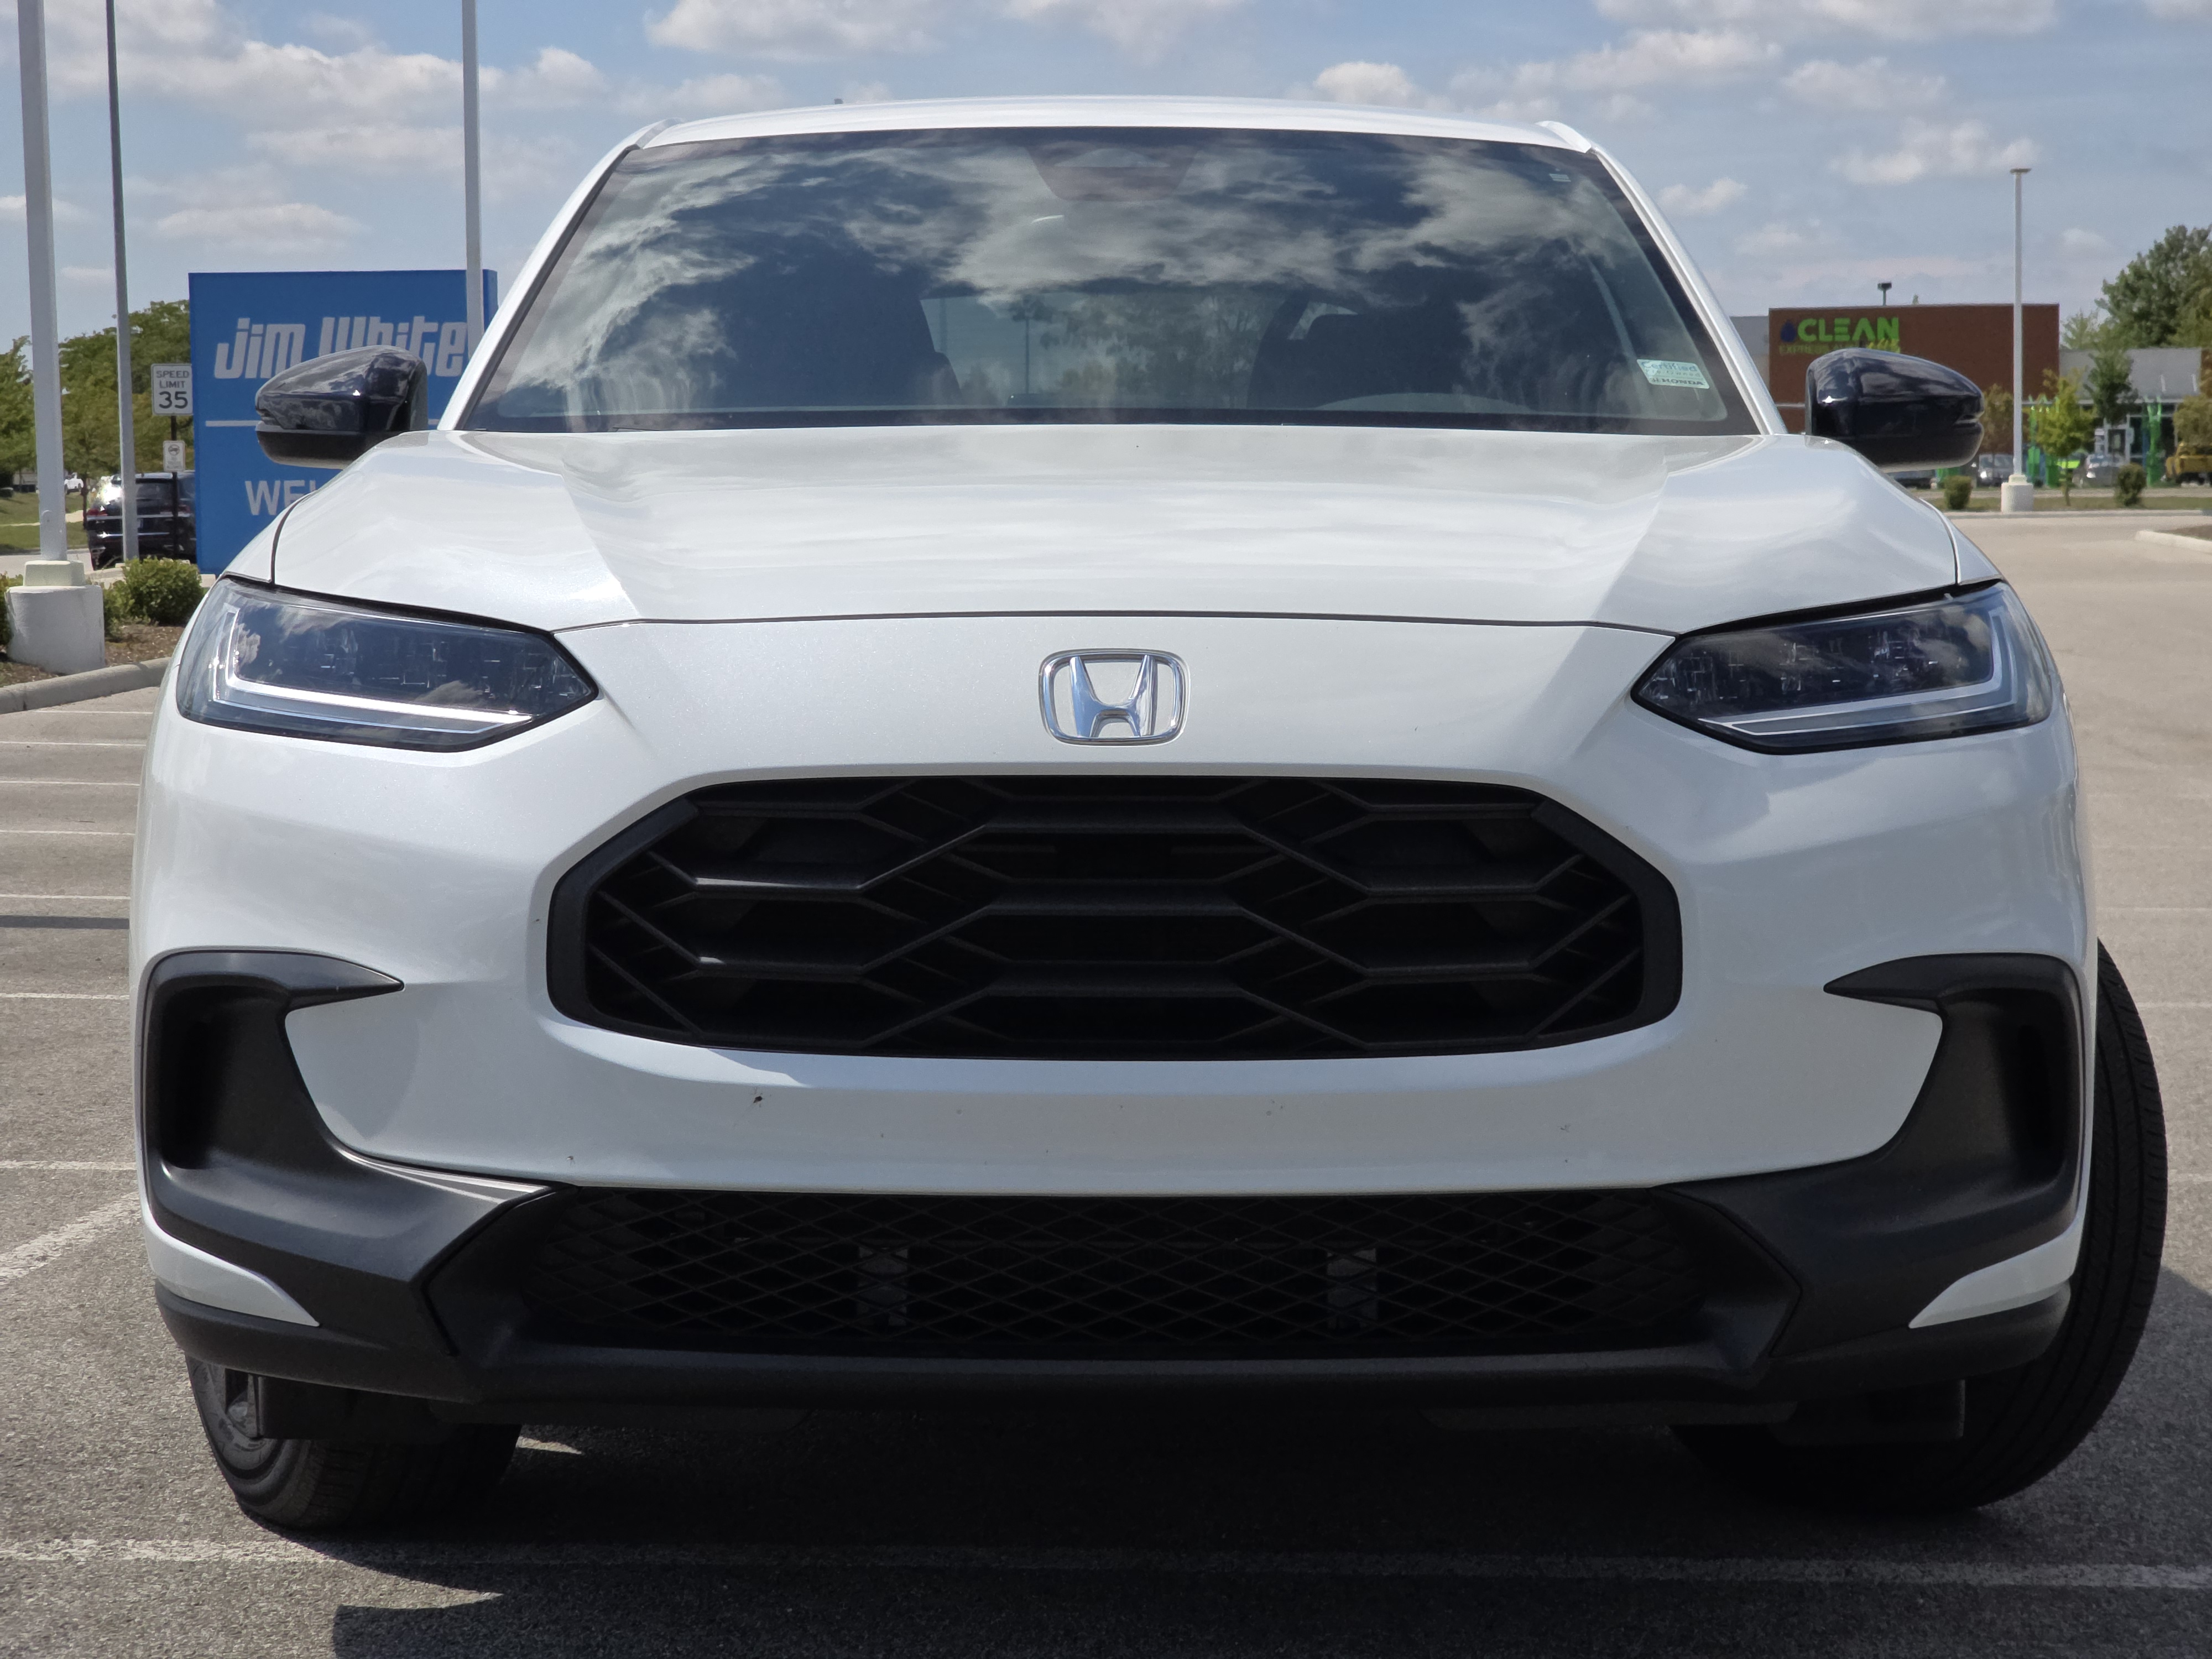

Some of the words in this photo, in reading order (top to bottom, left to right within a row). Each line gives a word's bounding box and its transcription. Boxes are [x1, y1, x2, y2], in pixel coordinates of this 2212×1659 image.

[1798, 317, 1899, 342] CLEAN
[156, 370, 189, 378] SPEED
[159, 380, 186, 388] LIMIT
[159, 391, 188, 409] 35
